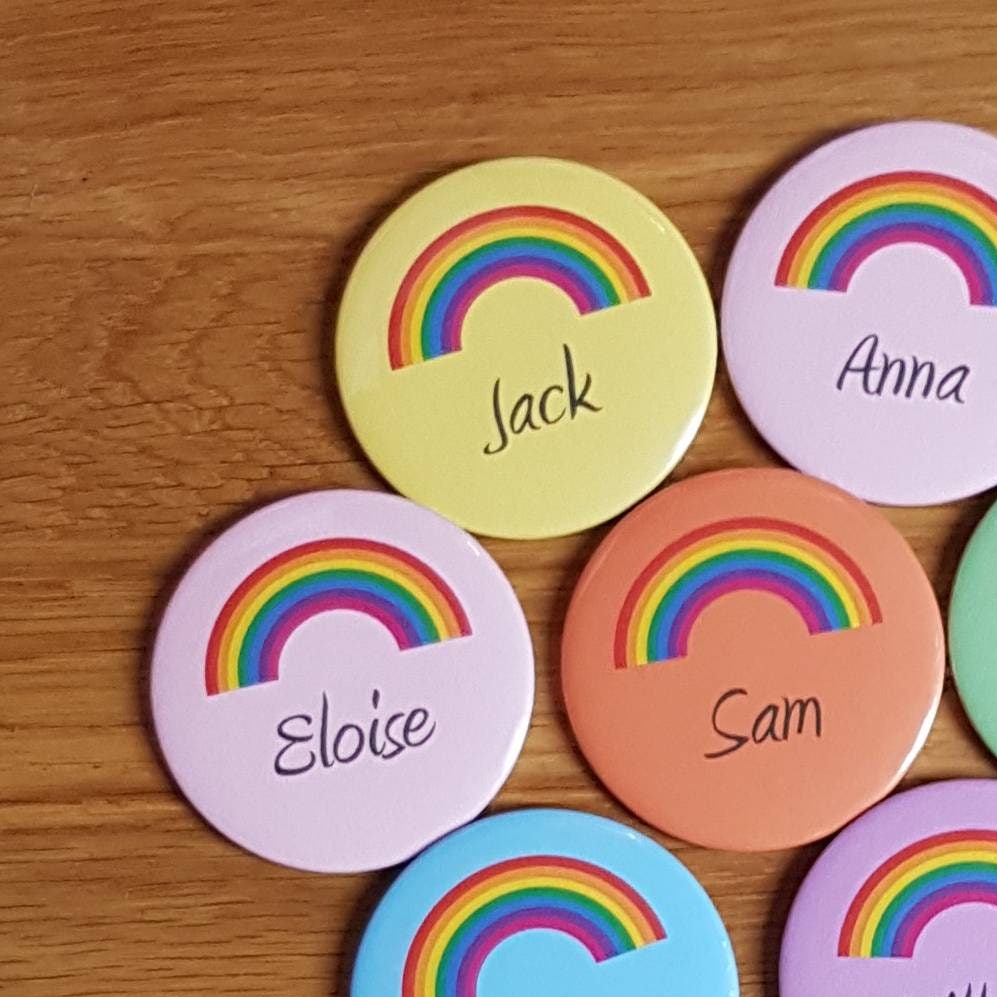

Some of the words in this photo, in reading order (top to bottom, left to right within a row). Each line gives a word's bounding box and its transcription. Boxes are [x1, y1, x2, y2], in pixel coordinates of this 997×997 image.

[483, 343, 602, 455] Jack
[836, 334, 970, 403] Anna
[274, 689, 436, 776] Eloise
[704, 688, 822, 759] Sam
